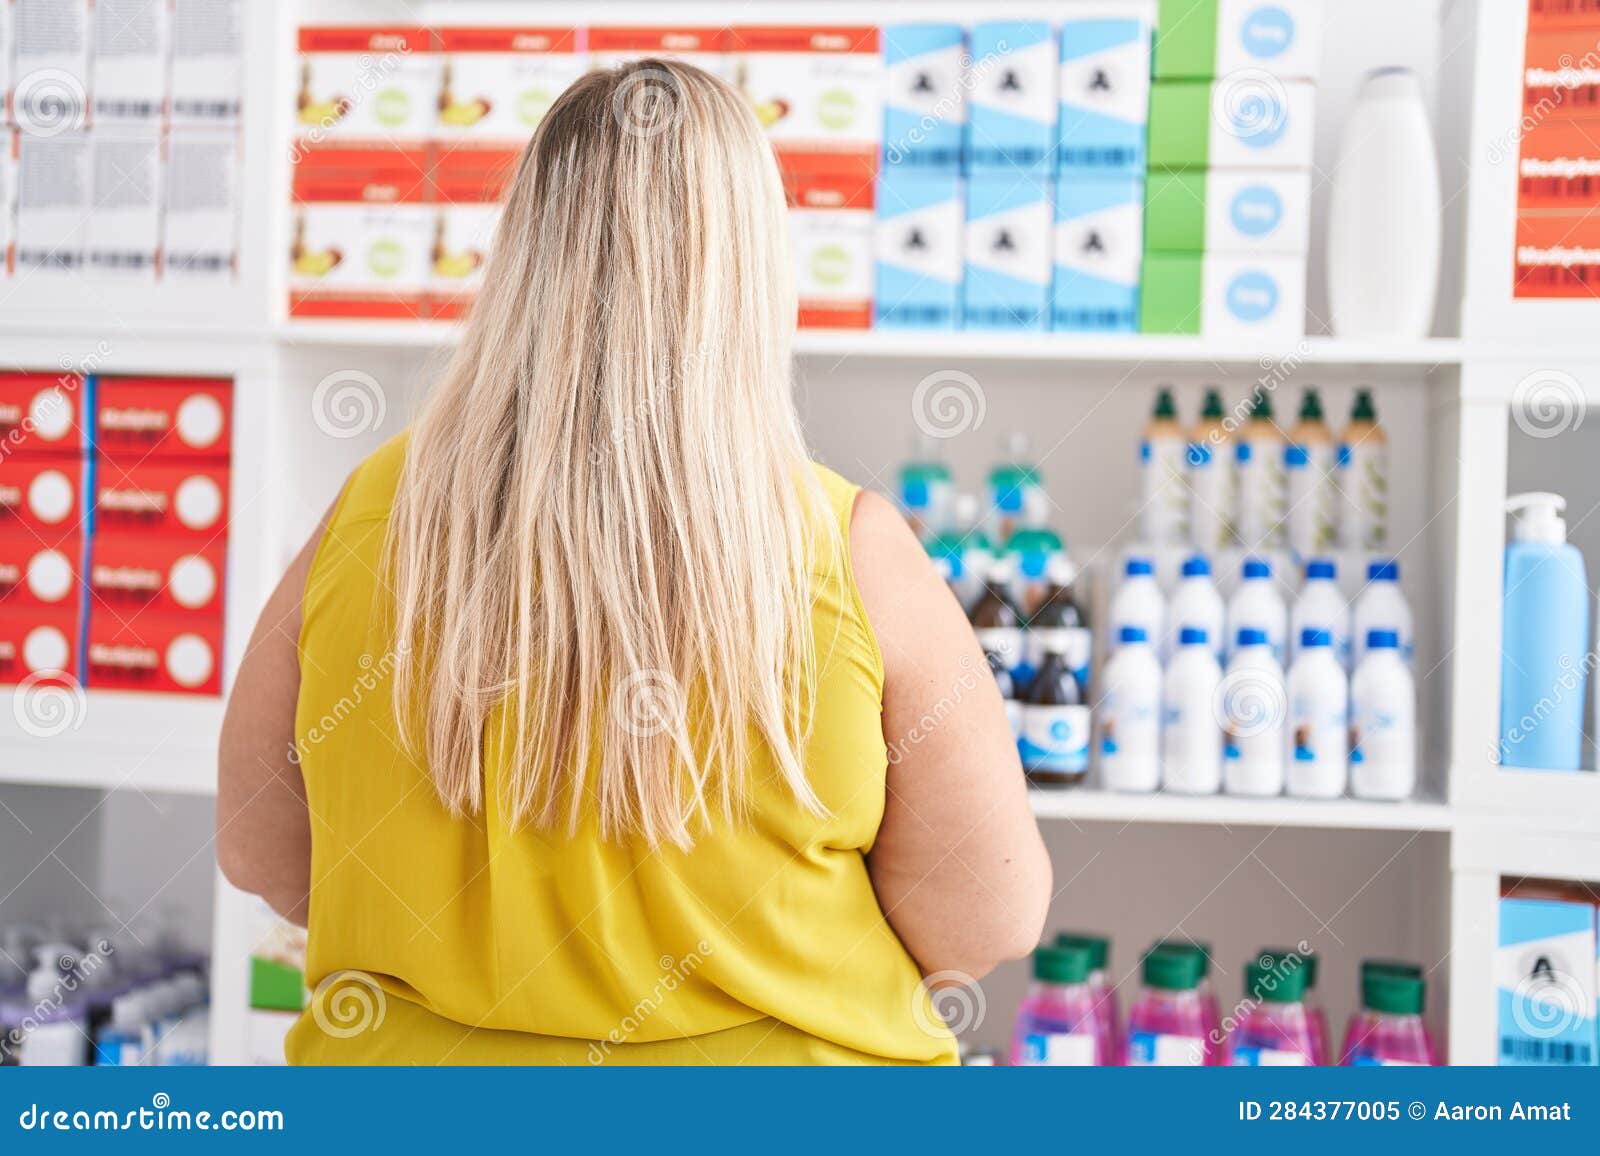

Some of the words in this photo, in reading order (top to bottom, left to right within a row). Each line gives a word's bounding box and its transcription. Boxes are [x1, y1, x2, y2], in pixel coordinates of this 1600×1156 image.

[915, 73, 934, 93] A
[1001, 70, 1021, 91] A
[1090, 70, 1110, 91] A
[907, 230, 926, 250] A
[995, 231, 1015, 251] A
[1084, 232, 1104, 253] A
[1531, 955, 1555, 983] A
